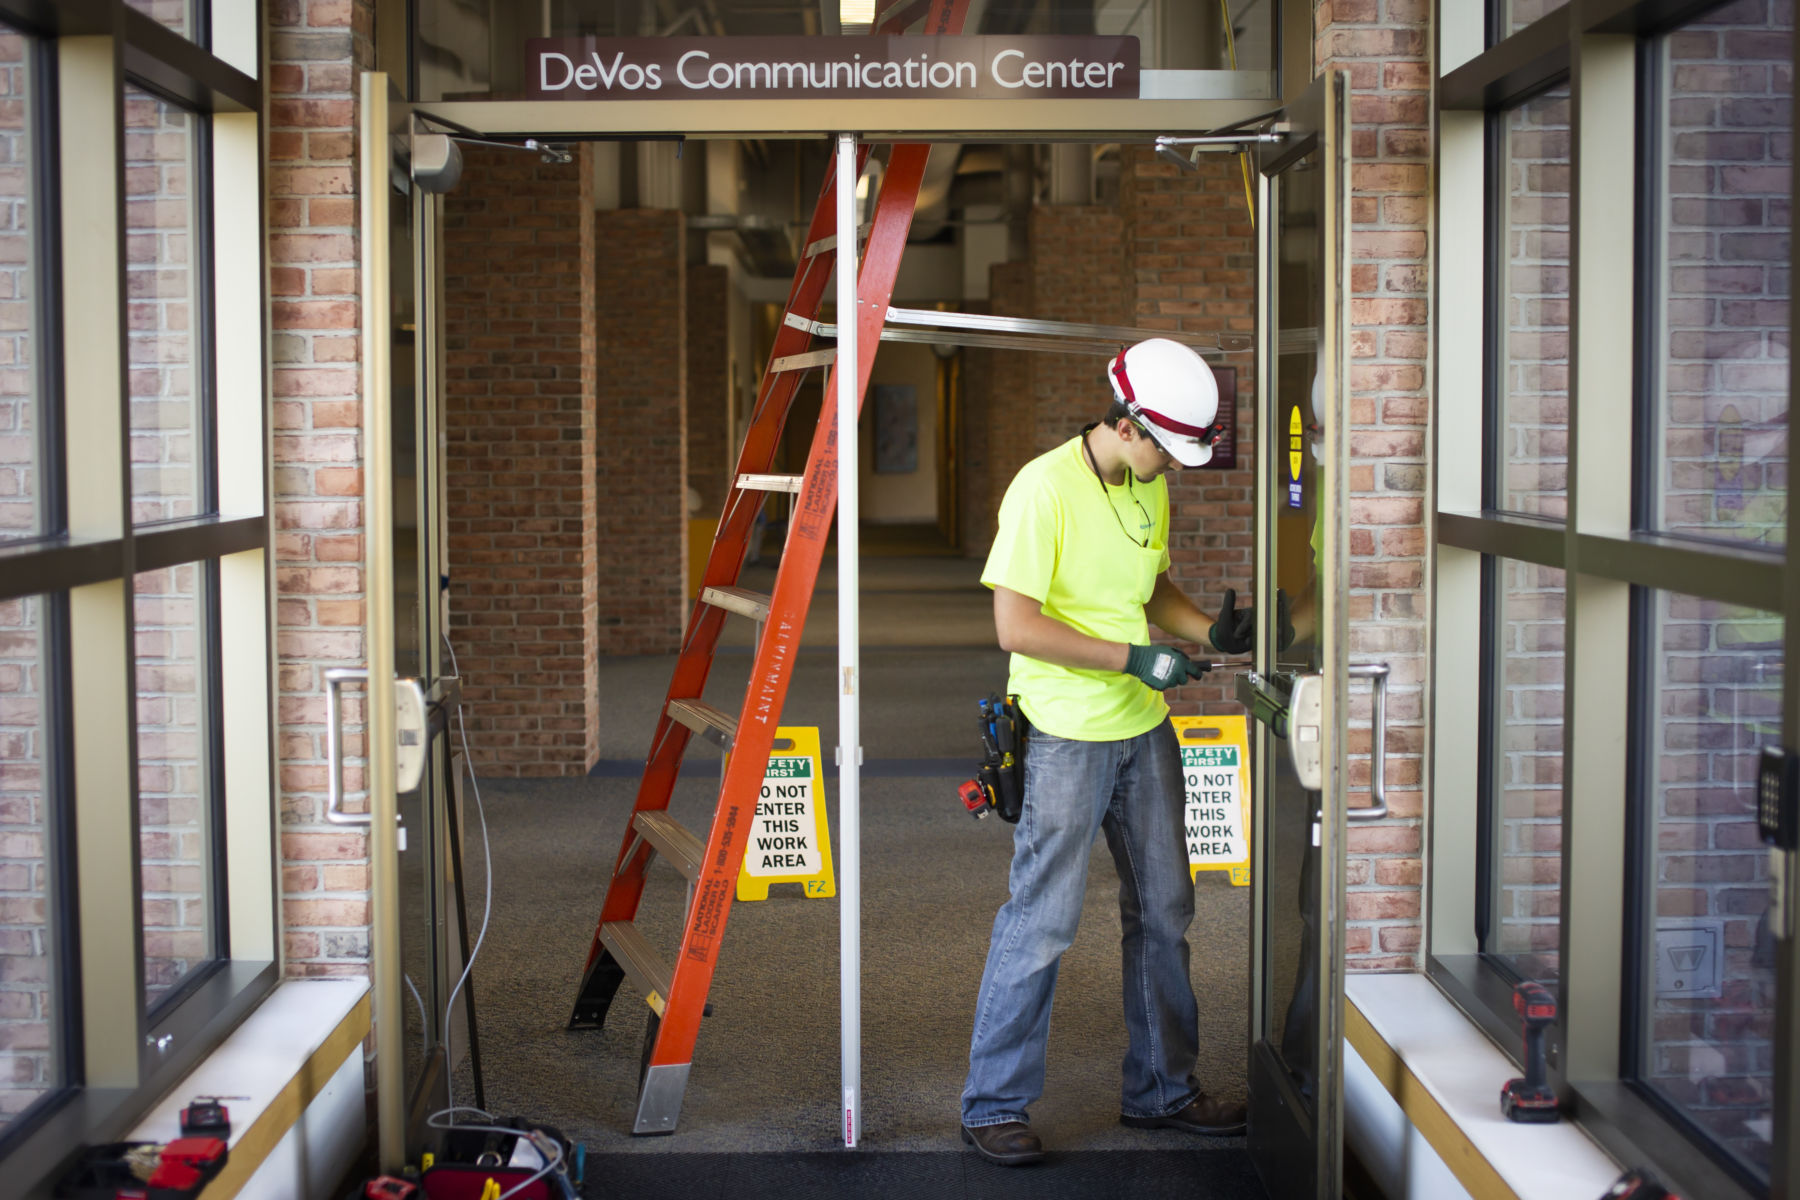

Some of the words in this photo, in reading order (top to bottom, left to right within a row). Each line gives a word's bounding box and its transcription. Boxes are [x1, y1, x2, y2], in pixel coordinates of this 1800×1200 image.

[539, 52, 661, 91] DeVos
[676, 50, 977, 90] Communication
[991, 49, 1124, 89] Center
[805, 458, 824, 510] NATIONAL
[1185, 757, 1223, 766] FIRST
[766, 768, 796, 777] IRST
[1184, 774, 1198, 787] O
[1203, 774, 1234, 786] NOT
[761, 785, 771, 798] O
[776, 785, 807, 798] NOT
[754, 802, 805, 815] ENTER
[1190, 808, 1226, 821] THIS
[763, 819, 799, 833] THIS
[1185, 825, 1234, 838] WORK
[757, 836, 808, 850] WORK
[1190, 842, 1232, 855] AREA
[762, 854, 806, 868] AREA
[694, 879, 713, 931] NATIONAL
[702, 889, 717, 934] LADDER
[710, 880, 728, 935] SCAFFOLD
